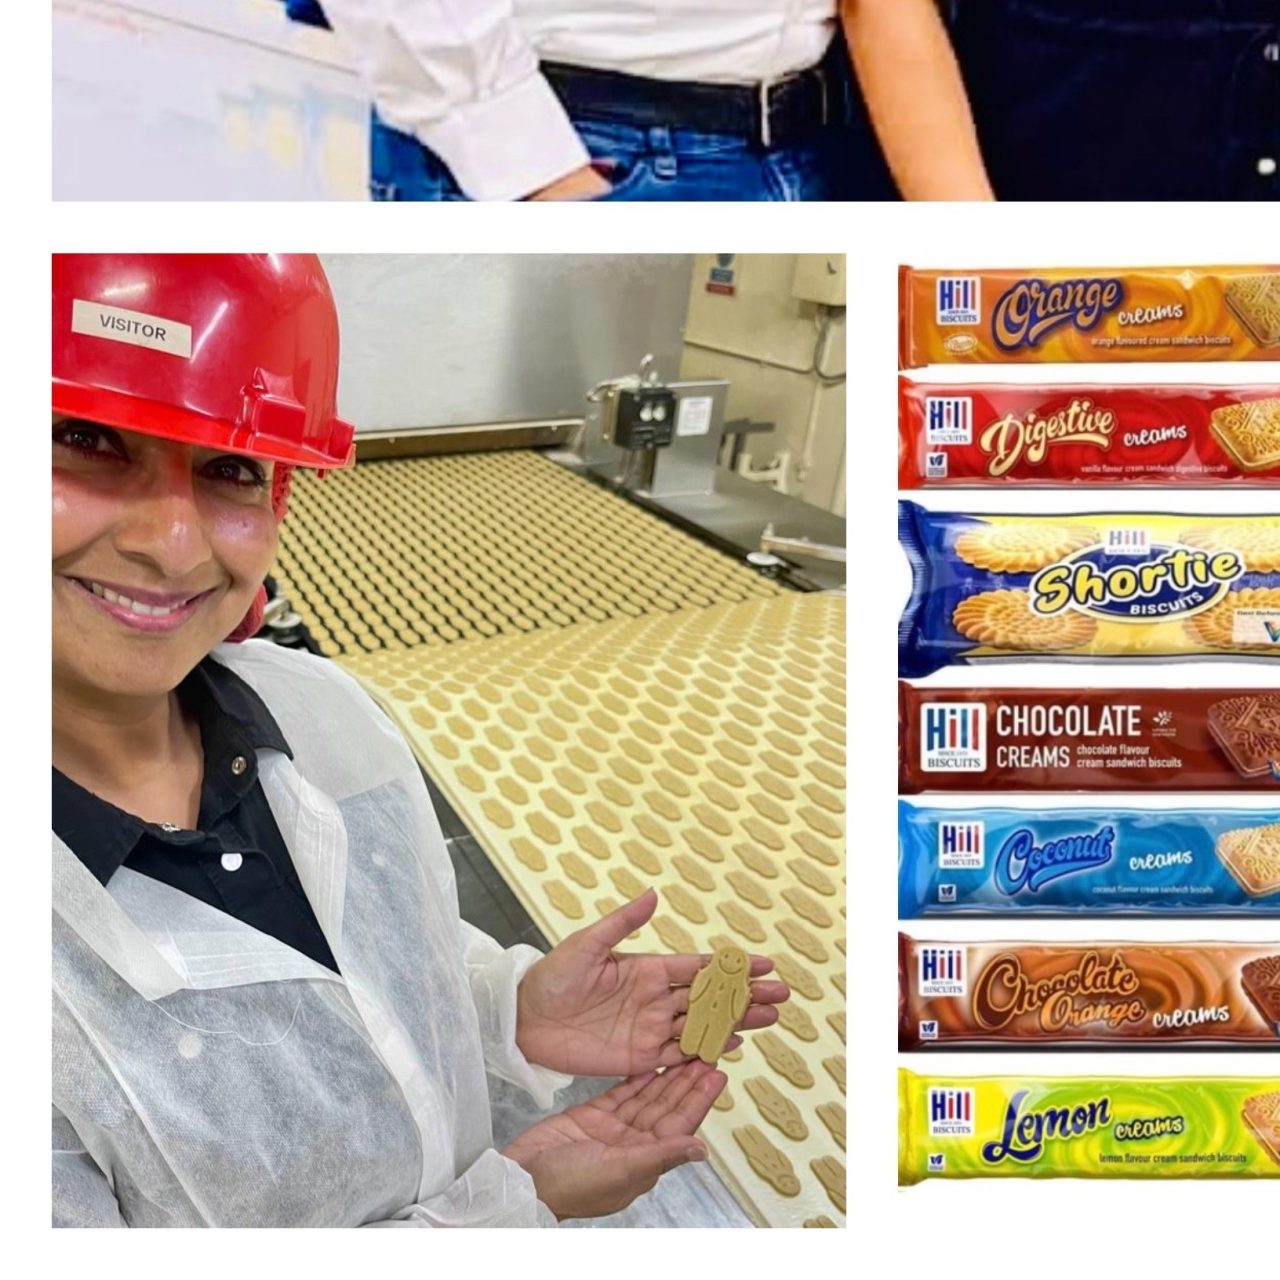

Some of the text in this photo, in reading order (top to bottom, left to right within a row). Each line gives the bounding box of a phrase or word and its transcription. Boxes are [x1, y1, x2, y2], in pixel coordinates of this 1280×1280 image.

[940, 279, 976, 311] Hill
[99, 313, 167, 341] VISITOR
[994, 280, 1120, 349] Orange
[1118, 304, 1184, 325] creams
[930, 400, 967, 430] Hill
[980, 400, 1188, 476] Digestive creams
[1109, 530, 1146, 546] Hill
[1034, 549, 1242, 614] Shortie
[1129, 592, 1204, 615] BISCUITS
[927, 708, 979, 751] Hill
[996, 705, 1141, 736] CHOCOLATE
[927, 758, 980, 768] BISCUITS
[996, 745, 1070, 768] CREAMS
[1077, 744, 1150, 755] chocolate flavour
[1077, 757, 1182, 768] cream sandwich biscuits
[943, 825, 980, 853] Hill
[995, 826, 1193, 896] Coconut creams
[923, 950, 962, 981] Hill
[973, 951, 1139, 1030] Chocolate
[1040, 990, 1230, 1032] Orange creams
[932, 1090, 970, 1122] Hill
[933, 1126, 971, 1134] BISCUITS
[983, 1090, 1183, 1162] Lemon creams
[1099, 1152, 1247, 1163] lemon flavour cream sandwich biscuits
